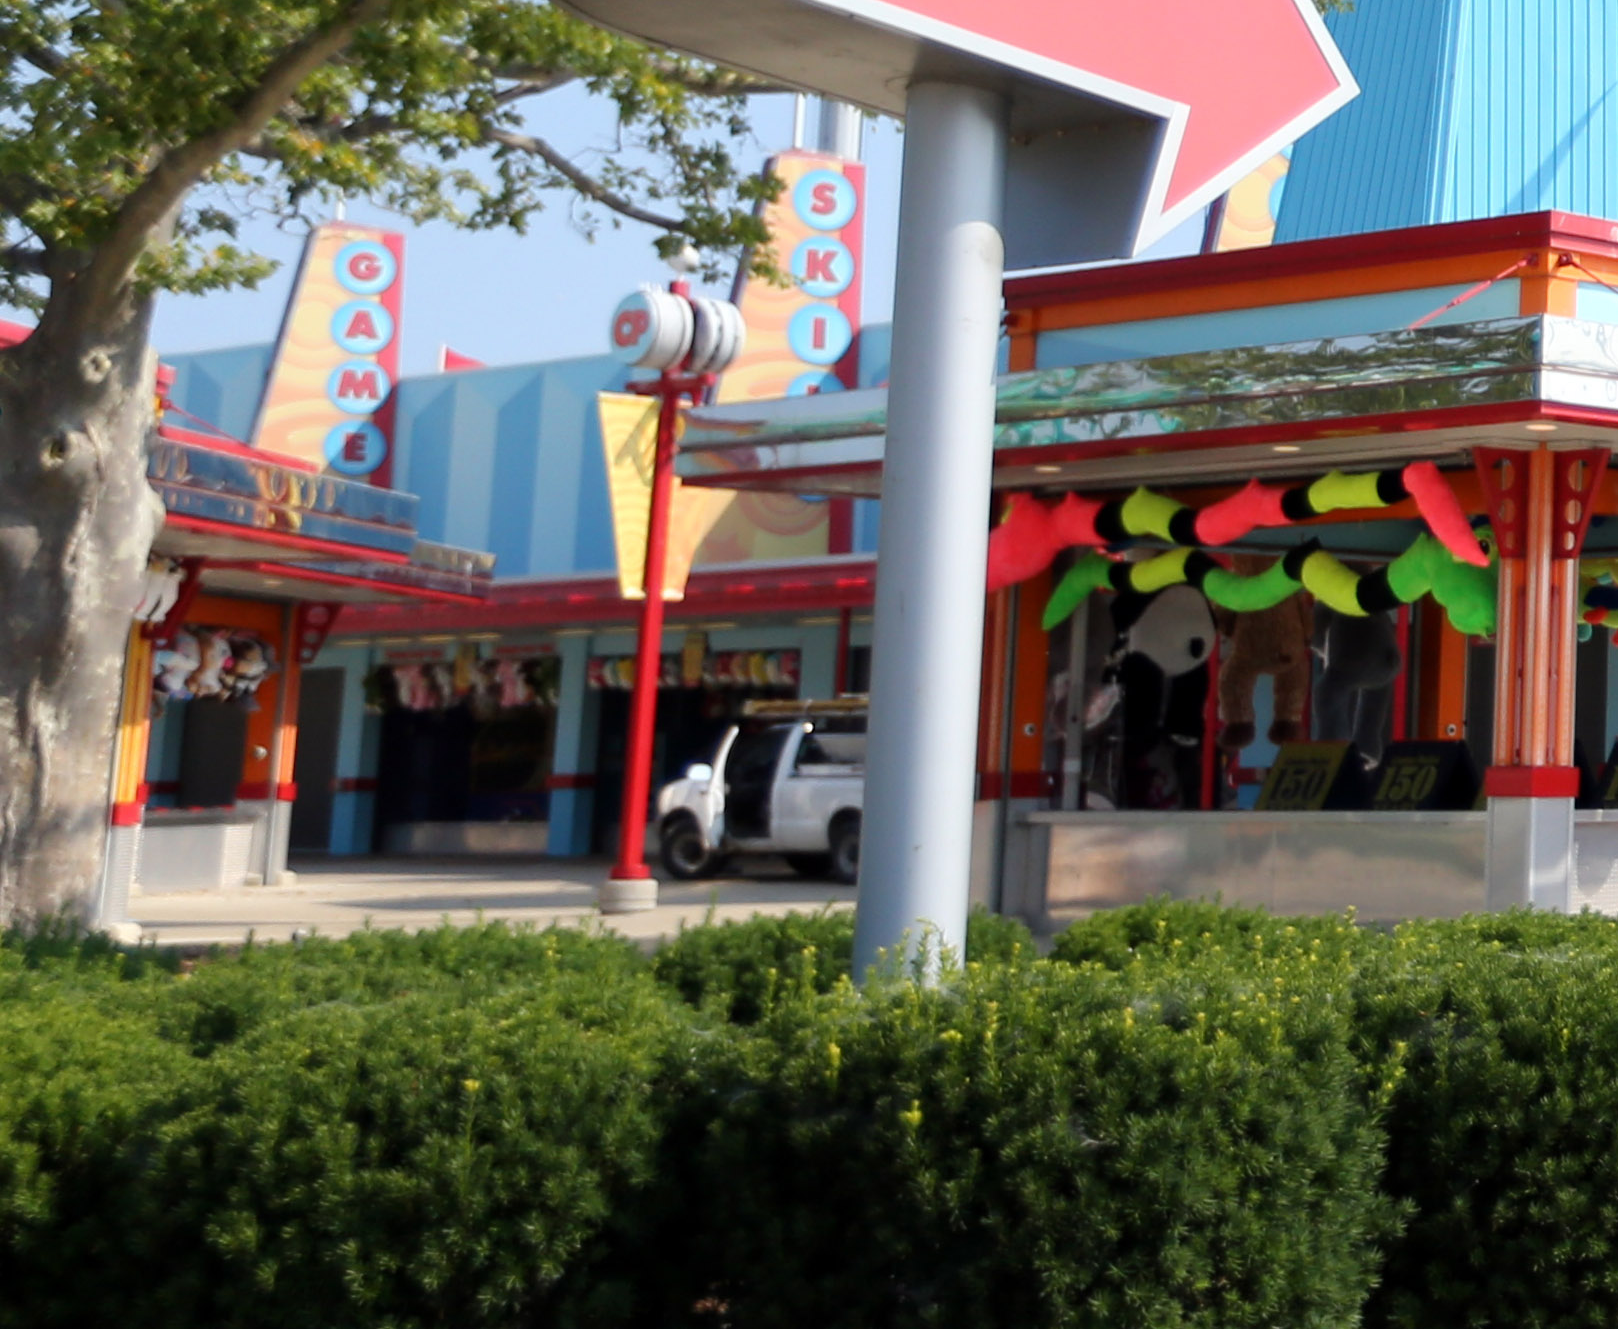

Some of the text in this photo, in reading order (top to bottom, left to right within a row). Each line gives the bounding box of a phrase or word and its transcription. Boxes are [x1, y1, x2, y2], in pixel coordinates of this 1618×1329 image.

[805, 182, 840, 397] SKI
[613, 309, 649, 348] CP
[337, 251, 383, 463] GAME
[1269, 767, 1328, 801] 150
[1375, 765, 1439, 801] 150
